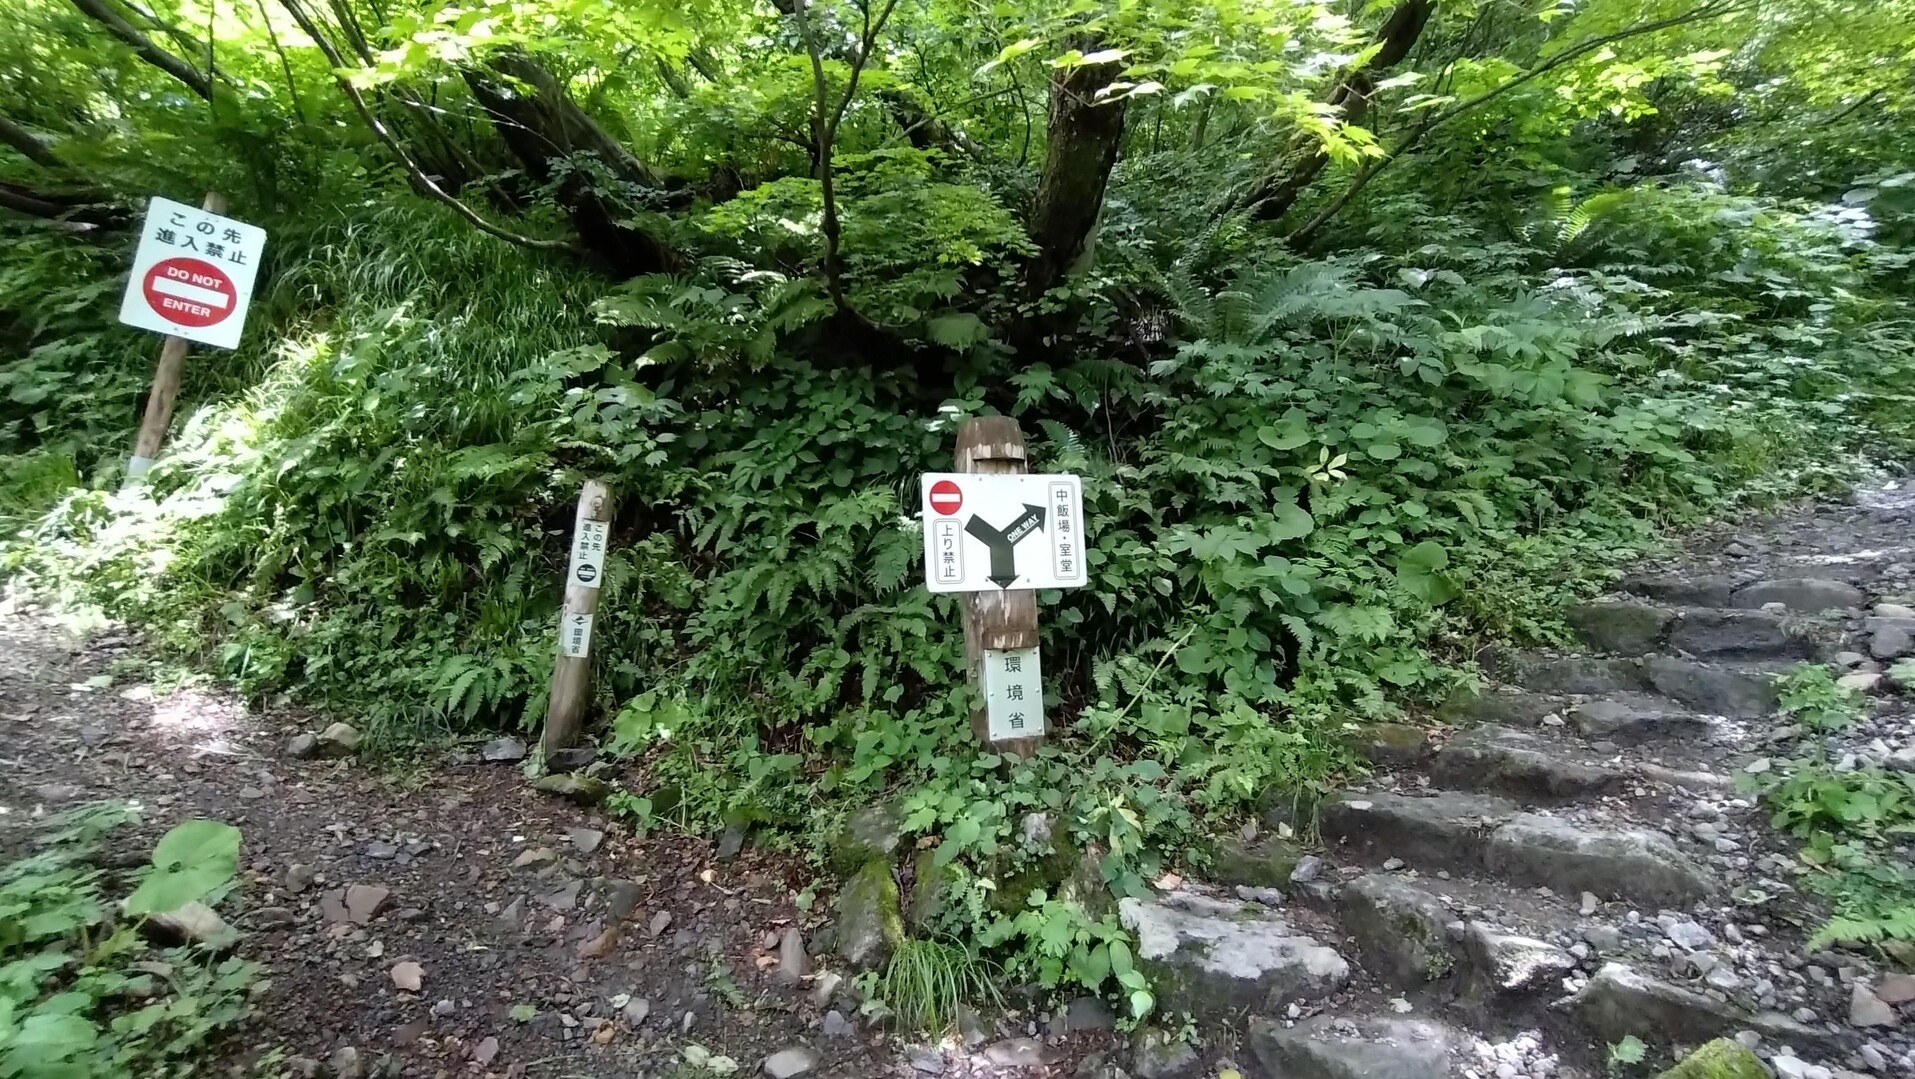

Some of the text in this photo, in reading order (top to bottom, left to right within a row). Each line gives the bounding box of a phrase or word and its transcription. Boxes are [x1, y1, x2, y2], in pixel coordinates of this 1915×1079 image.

[170, 212, 242, 244] この先
[155, 227, 247, 265] 進入禁止
[167, 266, 223, 289] DO NOT
[163, 297, 211, 317] ENTER
[578, 523, 591, 560] 進入禁止
[591, 524, 602, 551] この先
[1007, 513, 1038, 541] ONE WAY
[1056, 488, 1073, 573] 中飯場・室堂
[942, 524, 956, 578] 上り禁止
[571, 628, 583, 654] 環境省
[1004, 656, 1024, 729] 環境省
